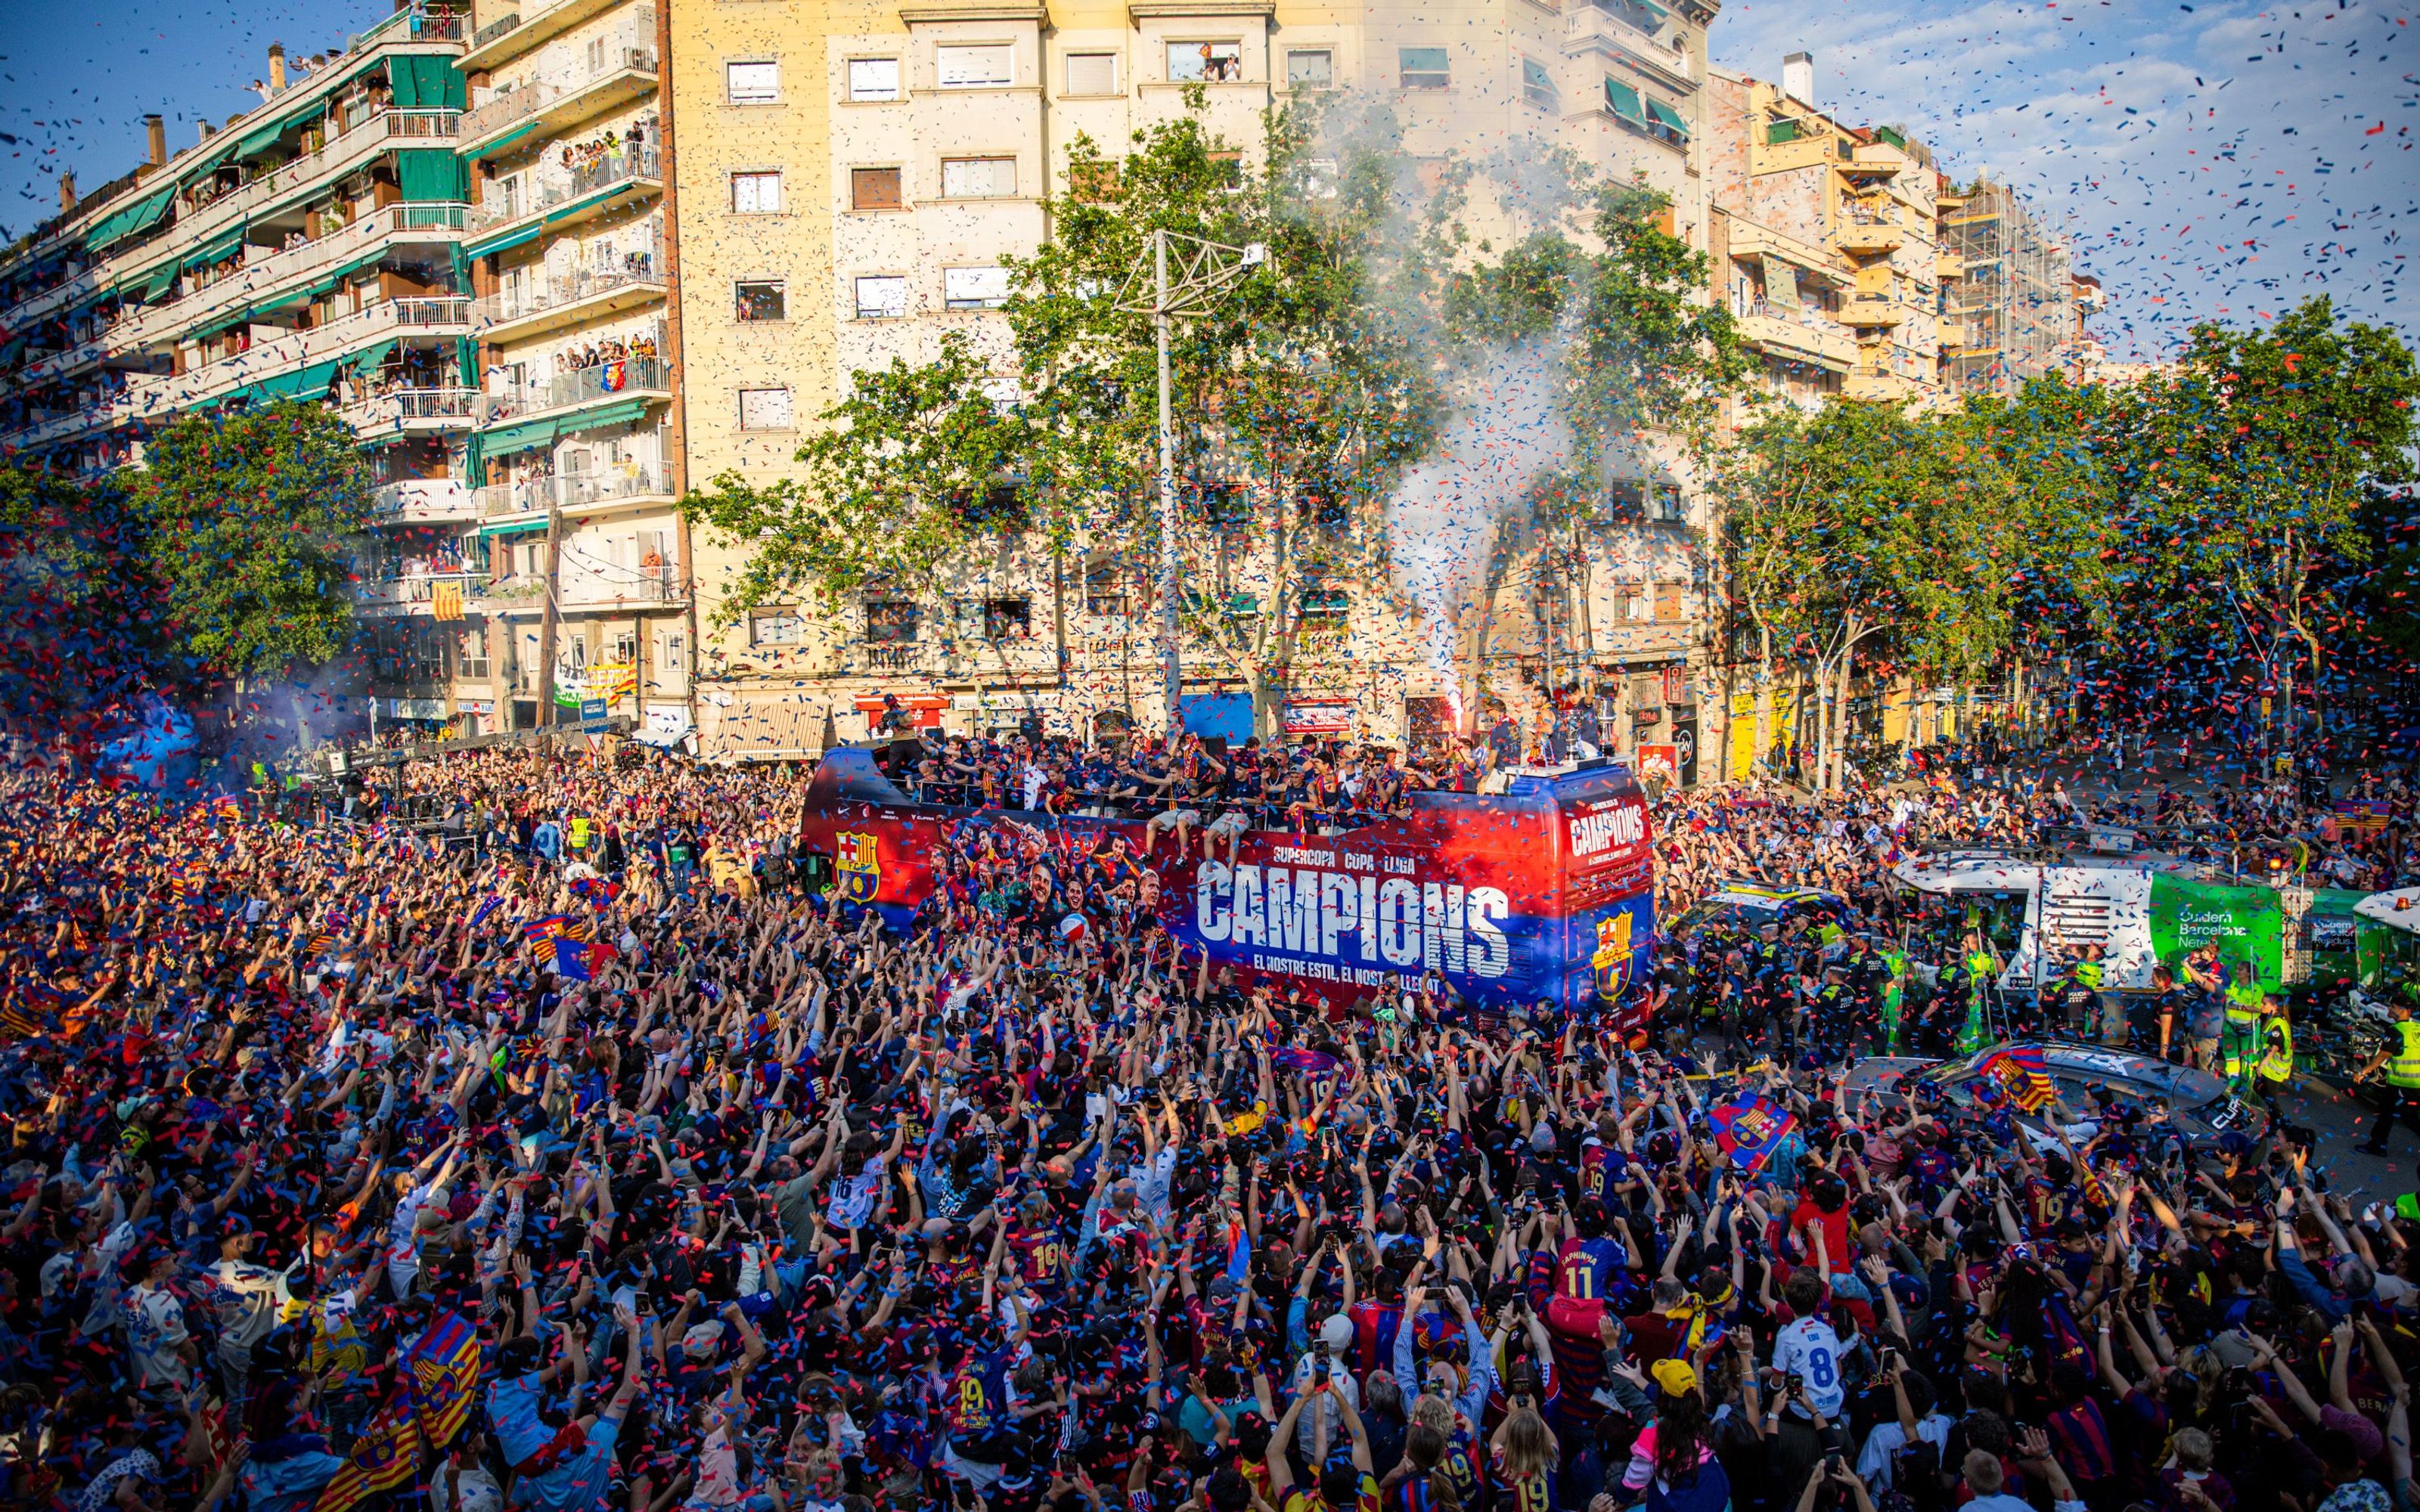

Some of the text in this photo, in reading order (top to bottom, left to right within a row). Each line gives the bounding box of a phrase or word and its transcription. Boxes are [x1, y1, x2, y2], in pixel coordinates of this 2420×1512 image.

[1570, 804, 1644, 857] CAMPIONS
[1274, 846, 1416, 875] SUPERCOPA COPA LLIGA
[1197, 861, 1509, 978] CAMPIONS
[2180, 911, 2232, 923] Cuidem
[2180, 923, 2246, 936] Barcelona
[1254, 953, 1265, 970] EL
[1267, 956, 1306, 978] NOSTRE
[1341, 966, 1354, 983] EL
[1590, 1170, 1604, 1195] 19
[2035, 1194, 2063, 1225] 19
[1032, 1243, 1059, 1278] 19
[1565, 1266, 1593, 1300] 11
[1809, 1347, 1835, 1388] 8
[959, 1377, 985, 1415] 19
[1514, 1476, 1549, 1512] 19
